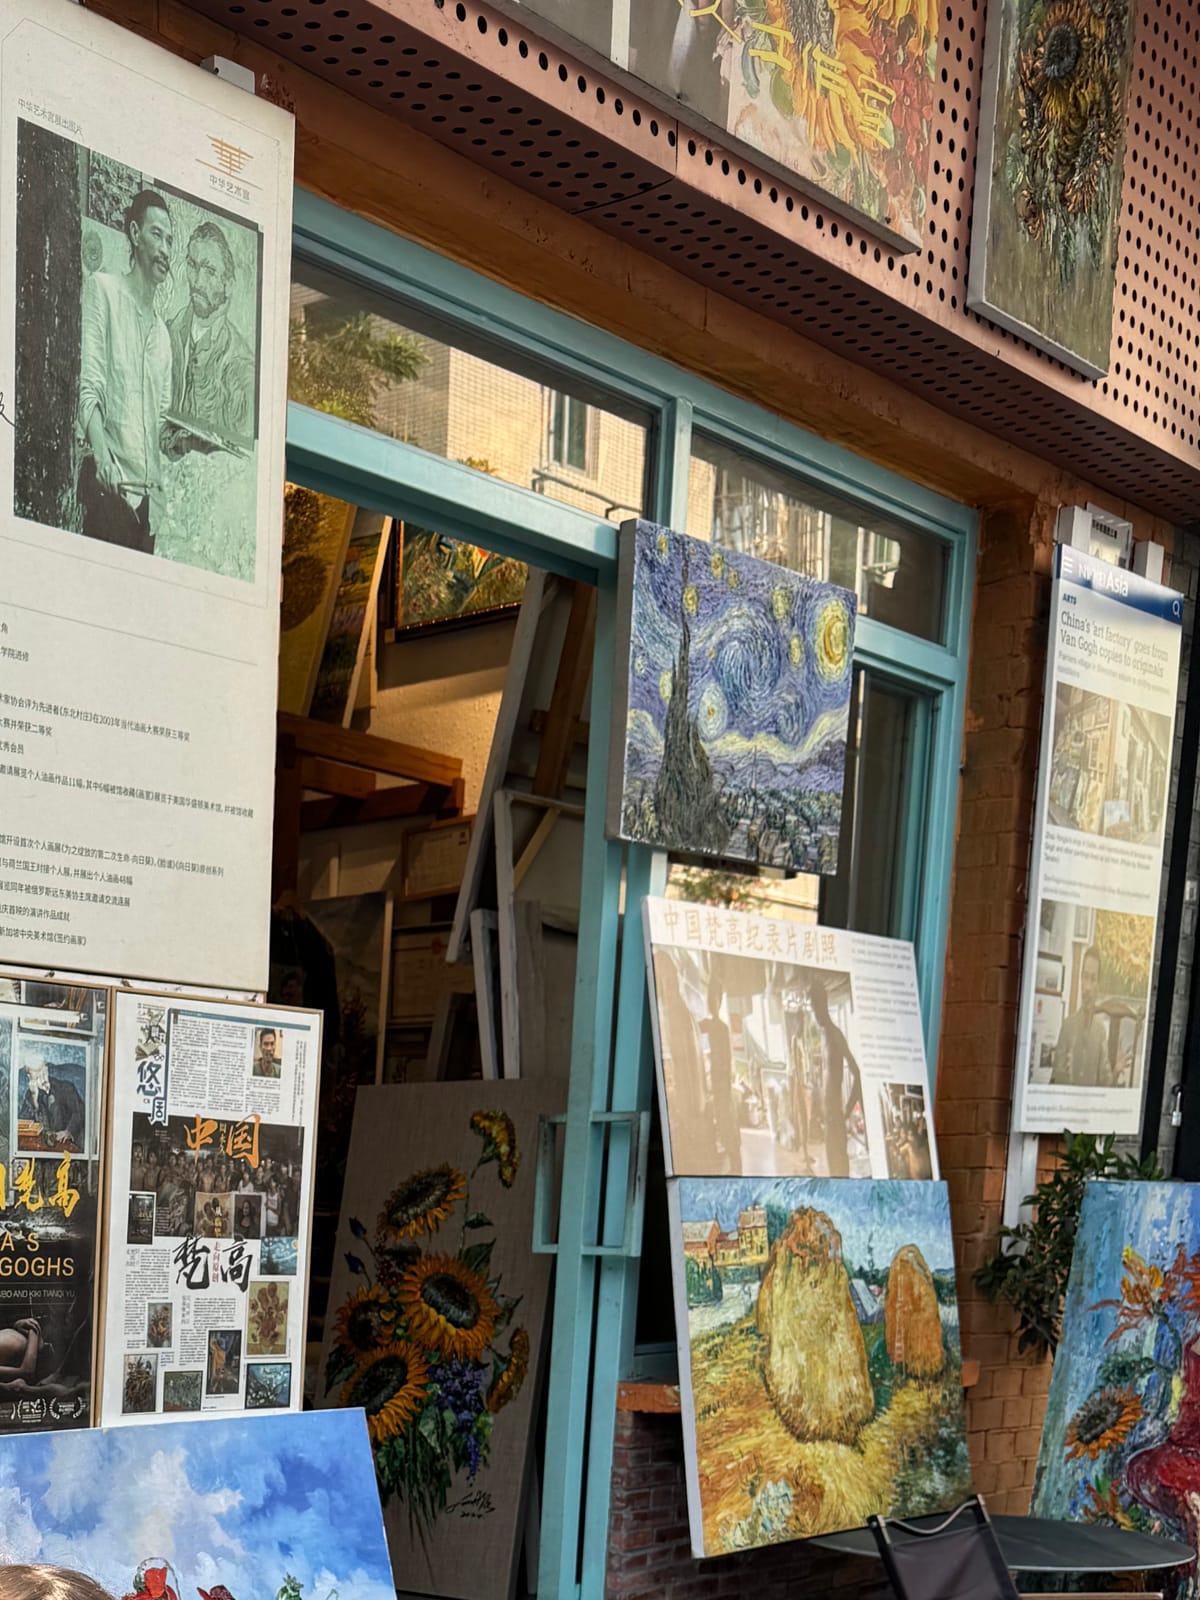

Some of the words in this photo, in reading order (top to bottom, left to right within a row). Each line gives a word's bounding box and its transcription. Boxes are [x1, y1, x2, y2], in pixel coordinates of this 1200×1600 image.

[1060, 629, 1076, 646] Van
[1078, 636, 1098, 656] Gogh
[1061, 611, 1090, 634] China's
[663, 904, 838, 964] 中国梵高纪录片剧照
[184, 1114, 261, 1168] 中国
[172, 1232, 253, 1292] 梵高
[13, 1290, 28, 1299] AND
